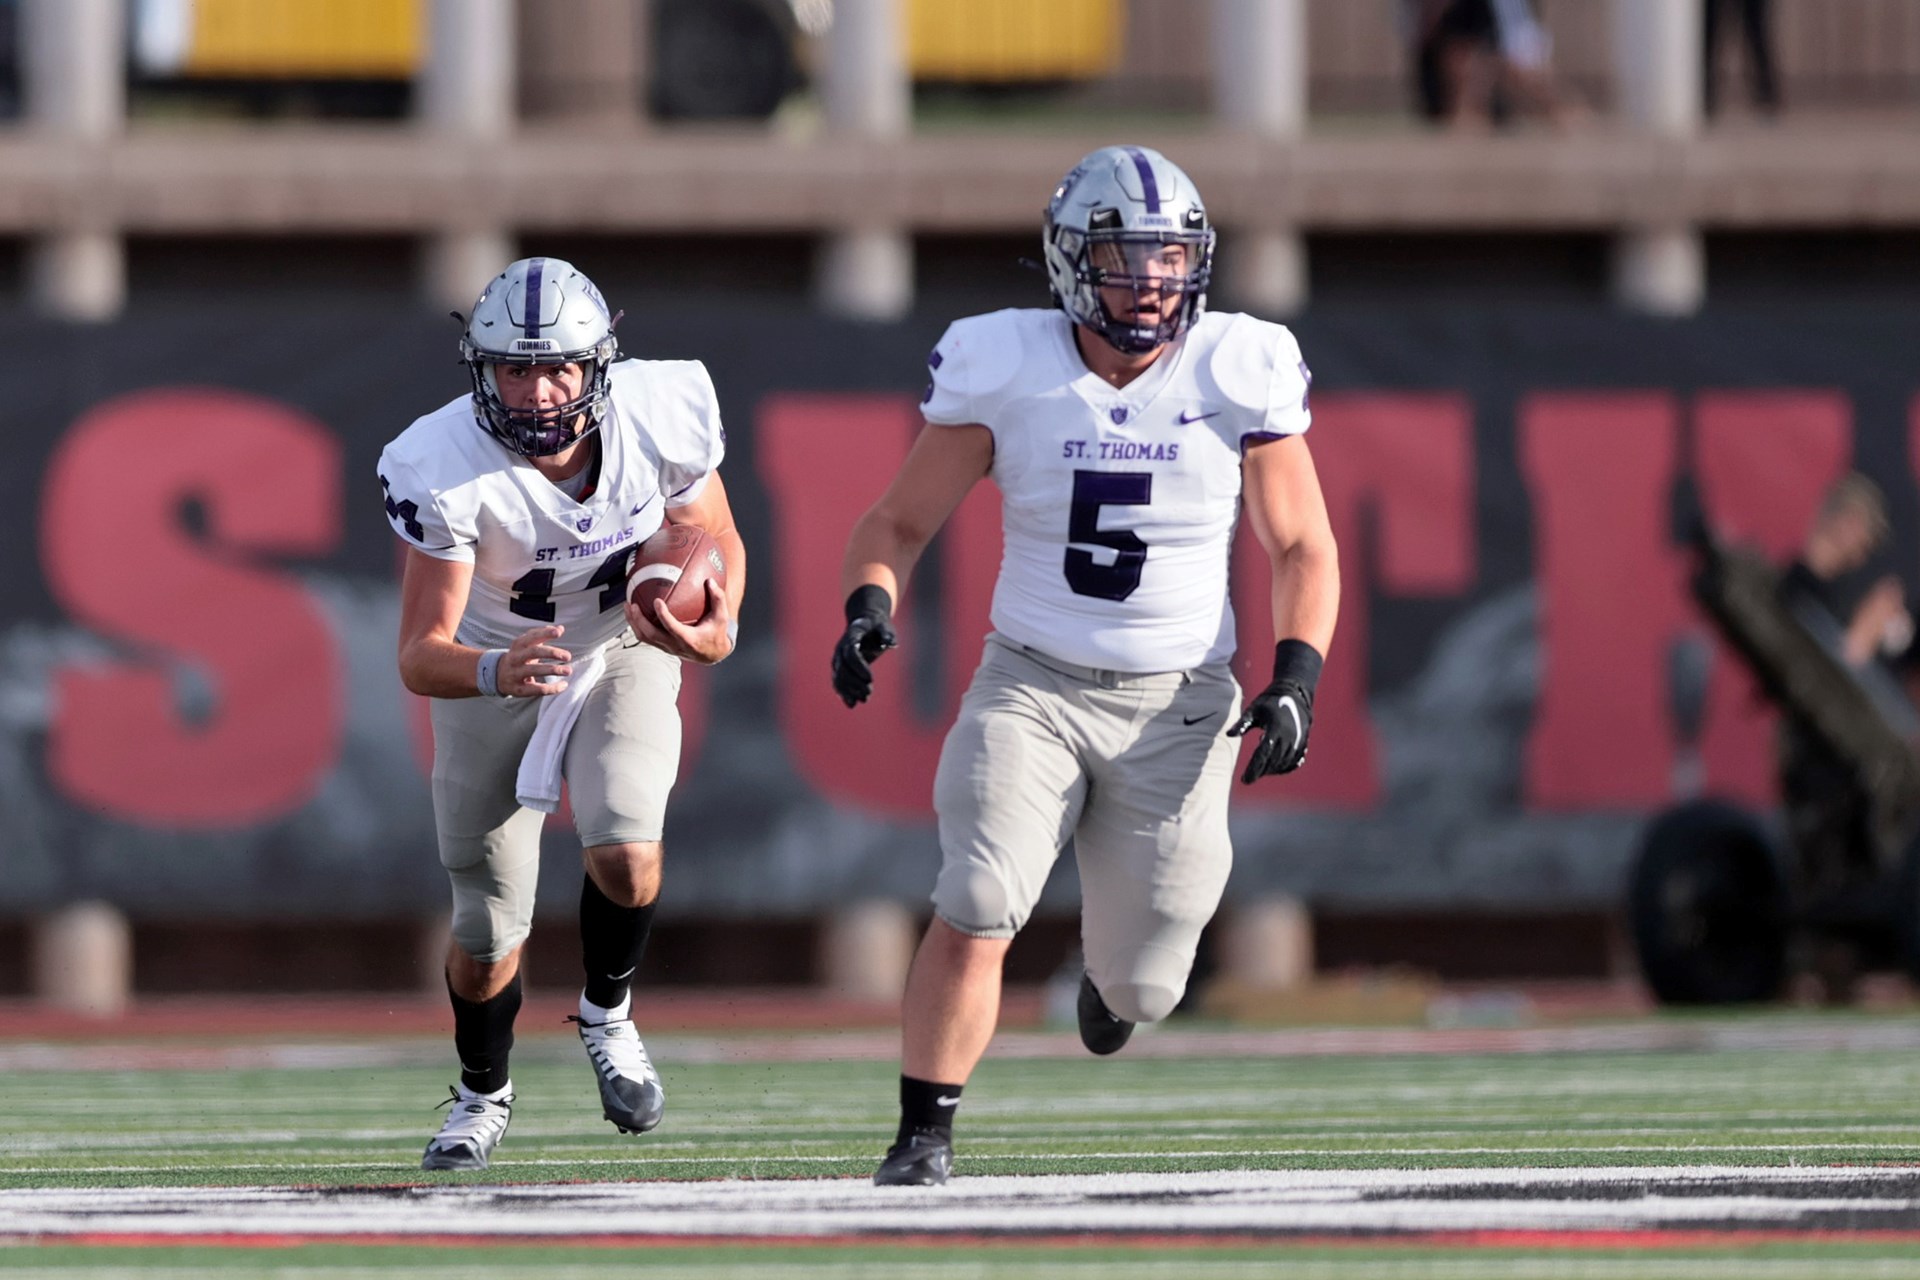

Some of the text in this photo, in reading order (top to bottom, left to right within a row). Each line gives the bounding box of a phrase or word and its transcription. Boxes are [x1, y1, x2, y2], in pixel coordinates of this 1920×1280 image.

[516, 340, 552, 351] TOMMIES
[1062, 440, 1179, 461] ST. THOMAS
[534, 526, 635, 562] ST. THOMAS
[1063, 468, 1153, 603] 5
[509, 541, 642, 623] 14
